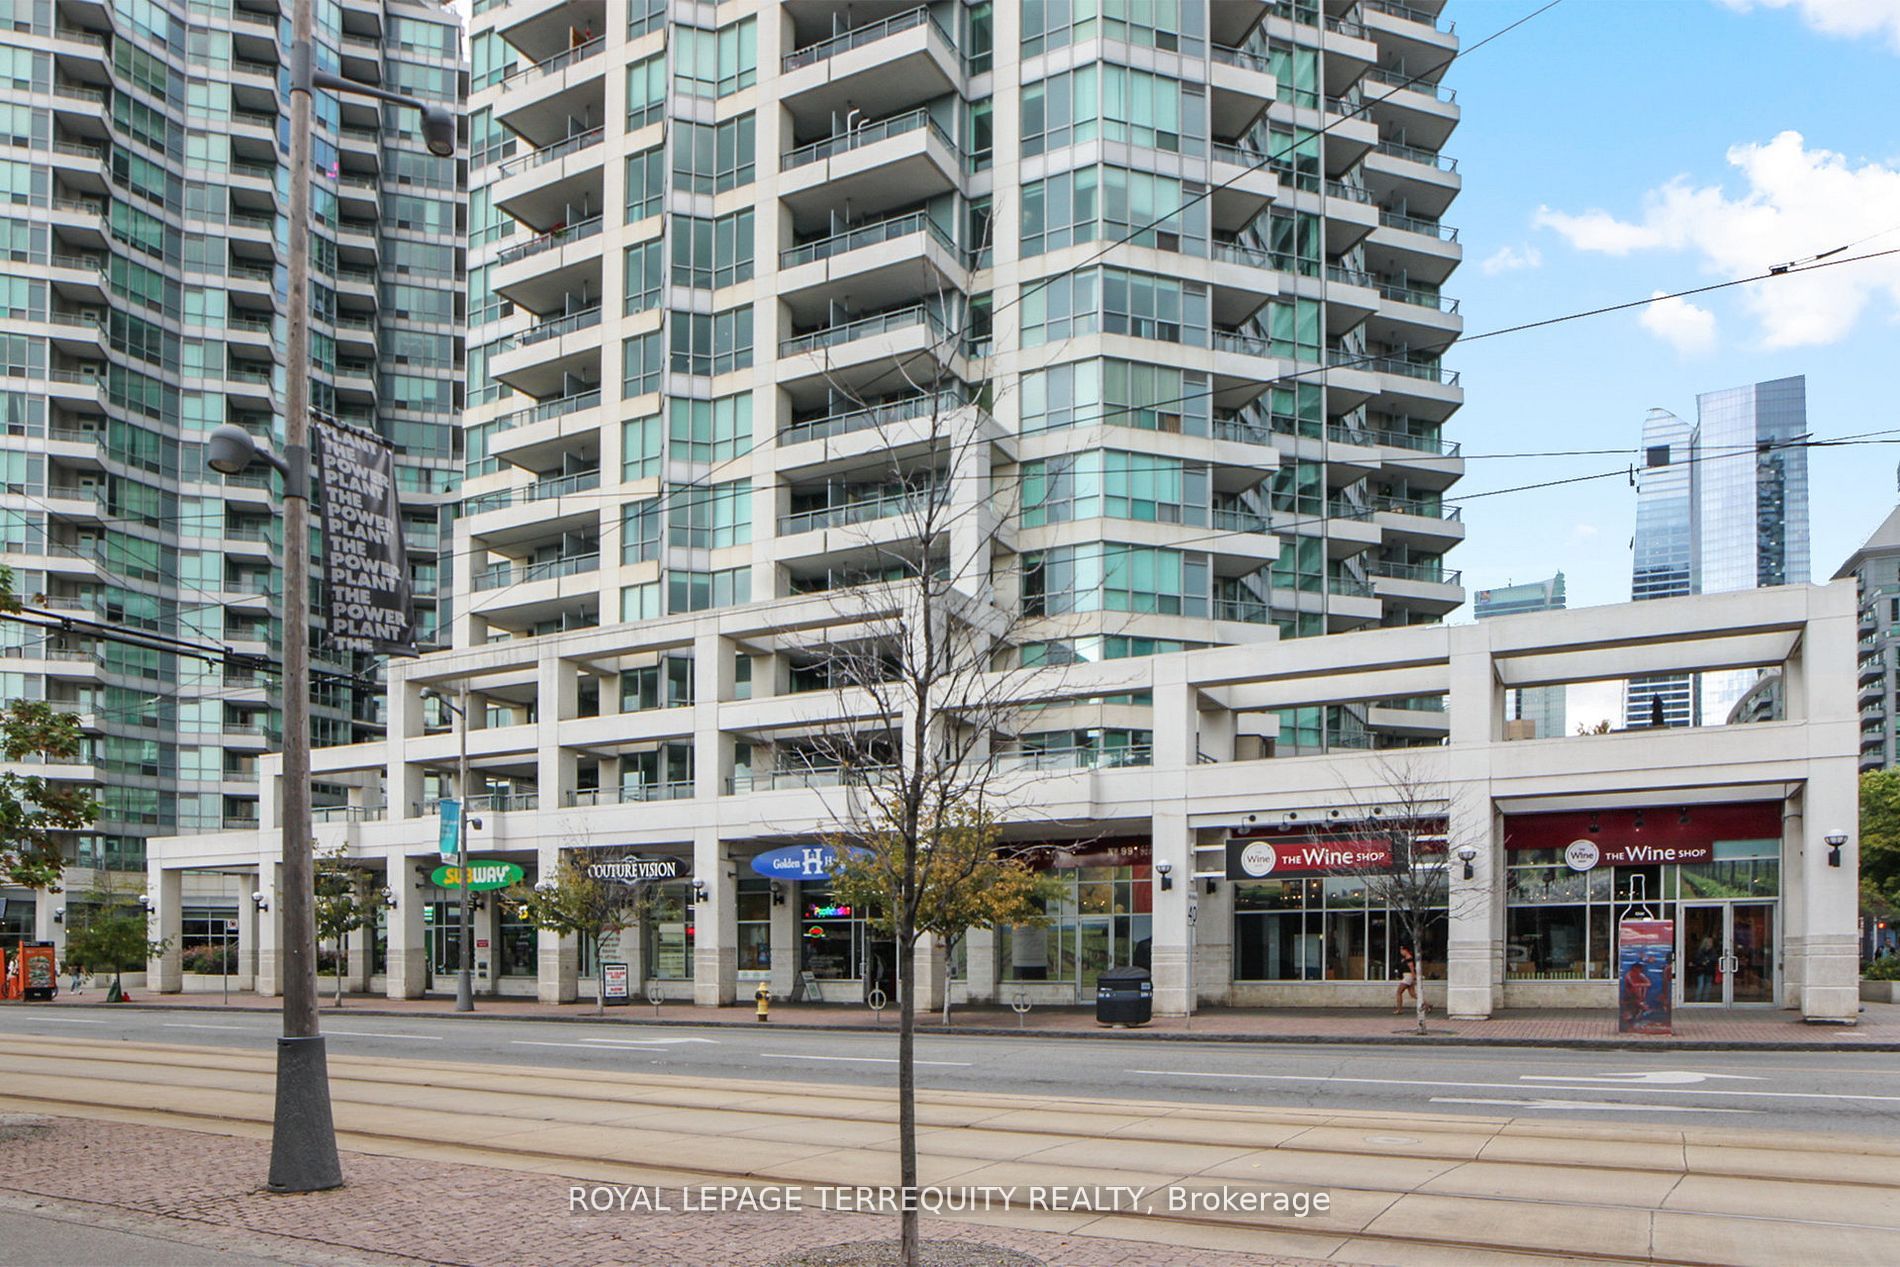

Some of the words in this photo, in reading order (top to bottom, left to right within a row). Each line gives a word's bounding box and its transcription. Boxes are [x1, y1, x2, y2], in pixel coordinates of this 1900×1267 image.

[320, 424, 378, 455] PLANT
[323, 453, 389, 489] POWER
[324, 469, 384, 501] PLANT
[326, 486, 363, 509] THE
[327, 502, 394, 535] POWER
[328, 518, 390, 546] PLANT
[329, 535, 367, 557] THE
[330, 551, 401, 580] POWER
[331, 567, 396, 593] PLANT
[332, 585, 371, 605] THE
[333, 602, 409, 629] POWER
[334, 619, 401, 641] PLANT
[334, 636, 374, 652] THE
[773, 858, 801, 870] Golden
[1247, 854, 1271, 863] Wine
[1282, 855, 1302, 865] THE
[1302, 848, 1355, 866] Wine
[1356, 851, 1386, 862] SHOP
[1571, 851, 1594, 860] Wine
[1606, 852, 1625, 861] THE
[1625, 845, 1676, 862] Wine
[1678, 848, 1707, 859] SHOP
[443, 865, 511, 885] SUBWAY
[587, 863, 637, 879] COUTURE
[638, 862, 677, 877] VISION
